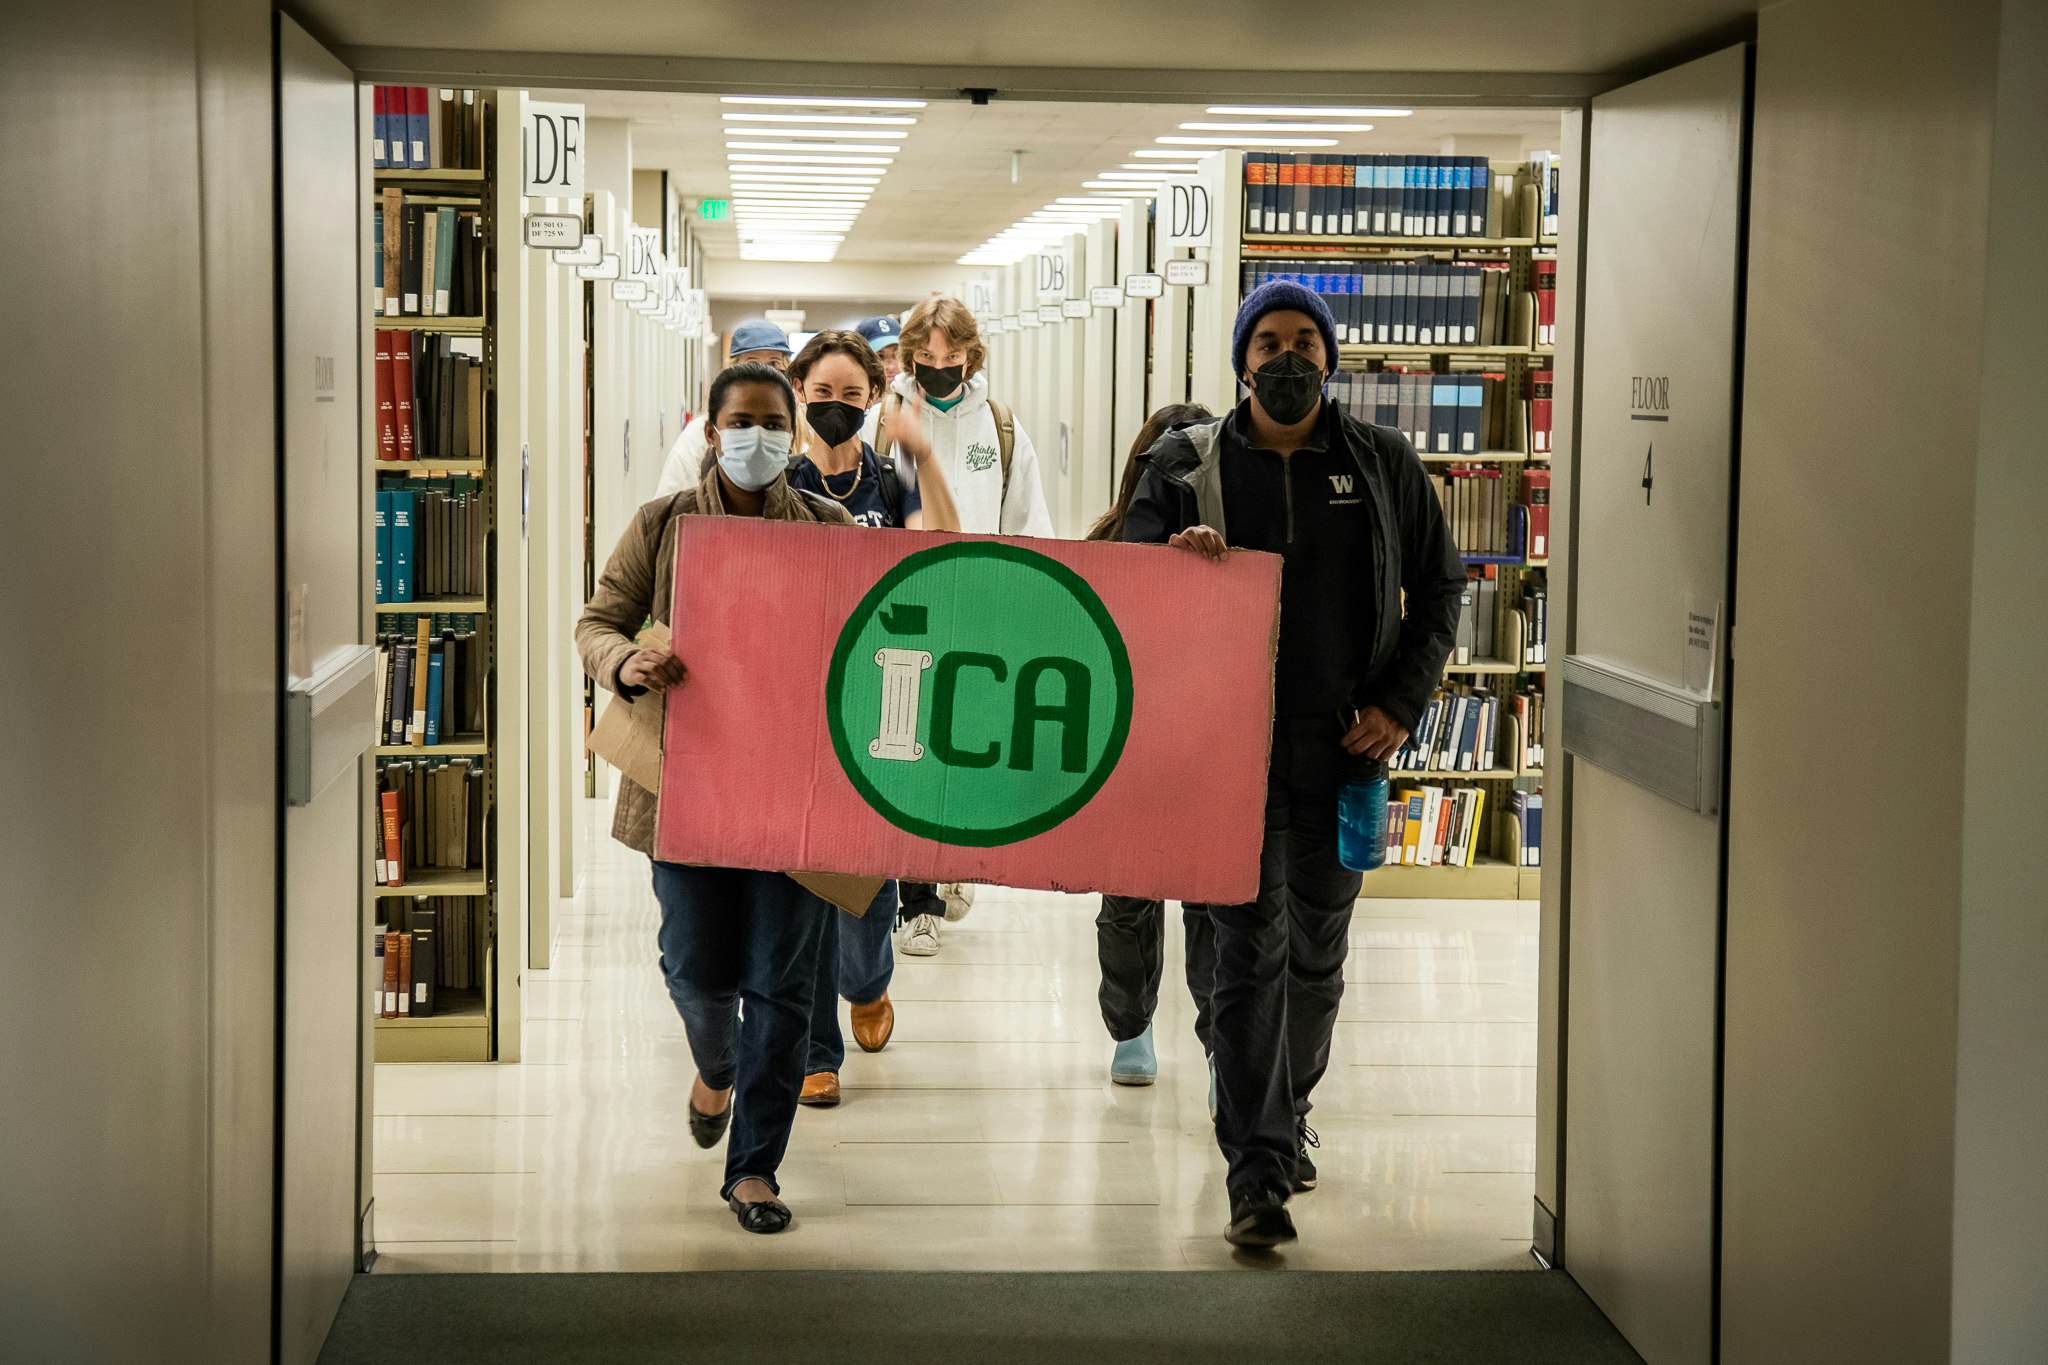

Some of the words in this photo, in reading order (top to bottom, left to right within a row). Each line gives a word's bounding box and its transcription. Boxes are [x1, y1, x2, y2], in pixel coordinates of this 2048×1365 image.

[532, 113, 580, 186] DF
[1170, 184, 1209, 237] DD
[632, 234, 657, 275] DK
[664, 272, 685, 302] DK
[1040, 254, 1065, 291] DB
[974, 285, 993, 313] DA
[878, 319, 890, 333] S
[1631, 376, 1670, 410] FLOOR
[966, 441, 997, 459] Thirty
[1328, 474, 1354, 494] W
[1642, 440, 1654, 506] 4
